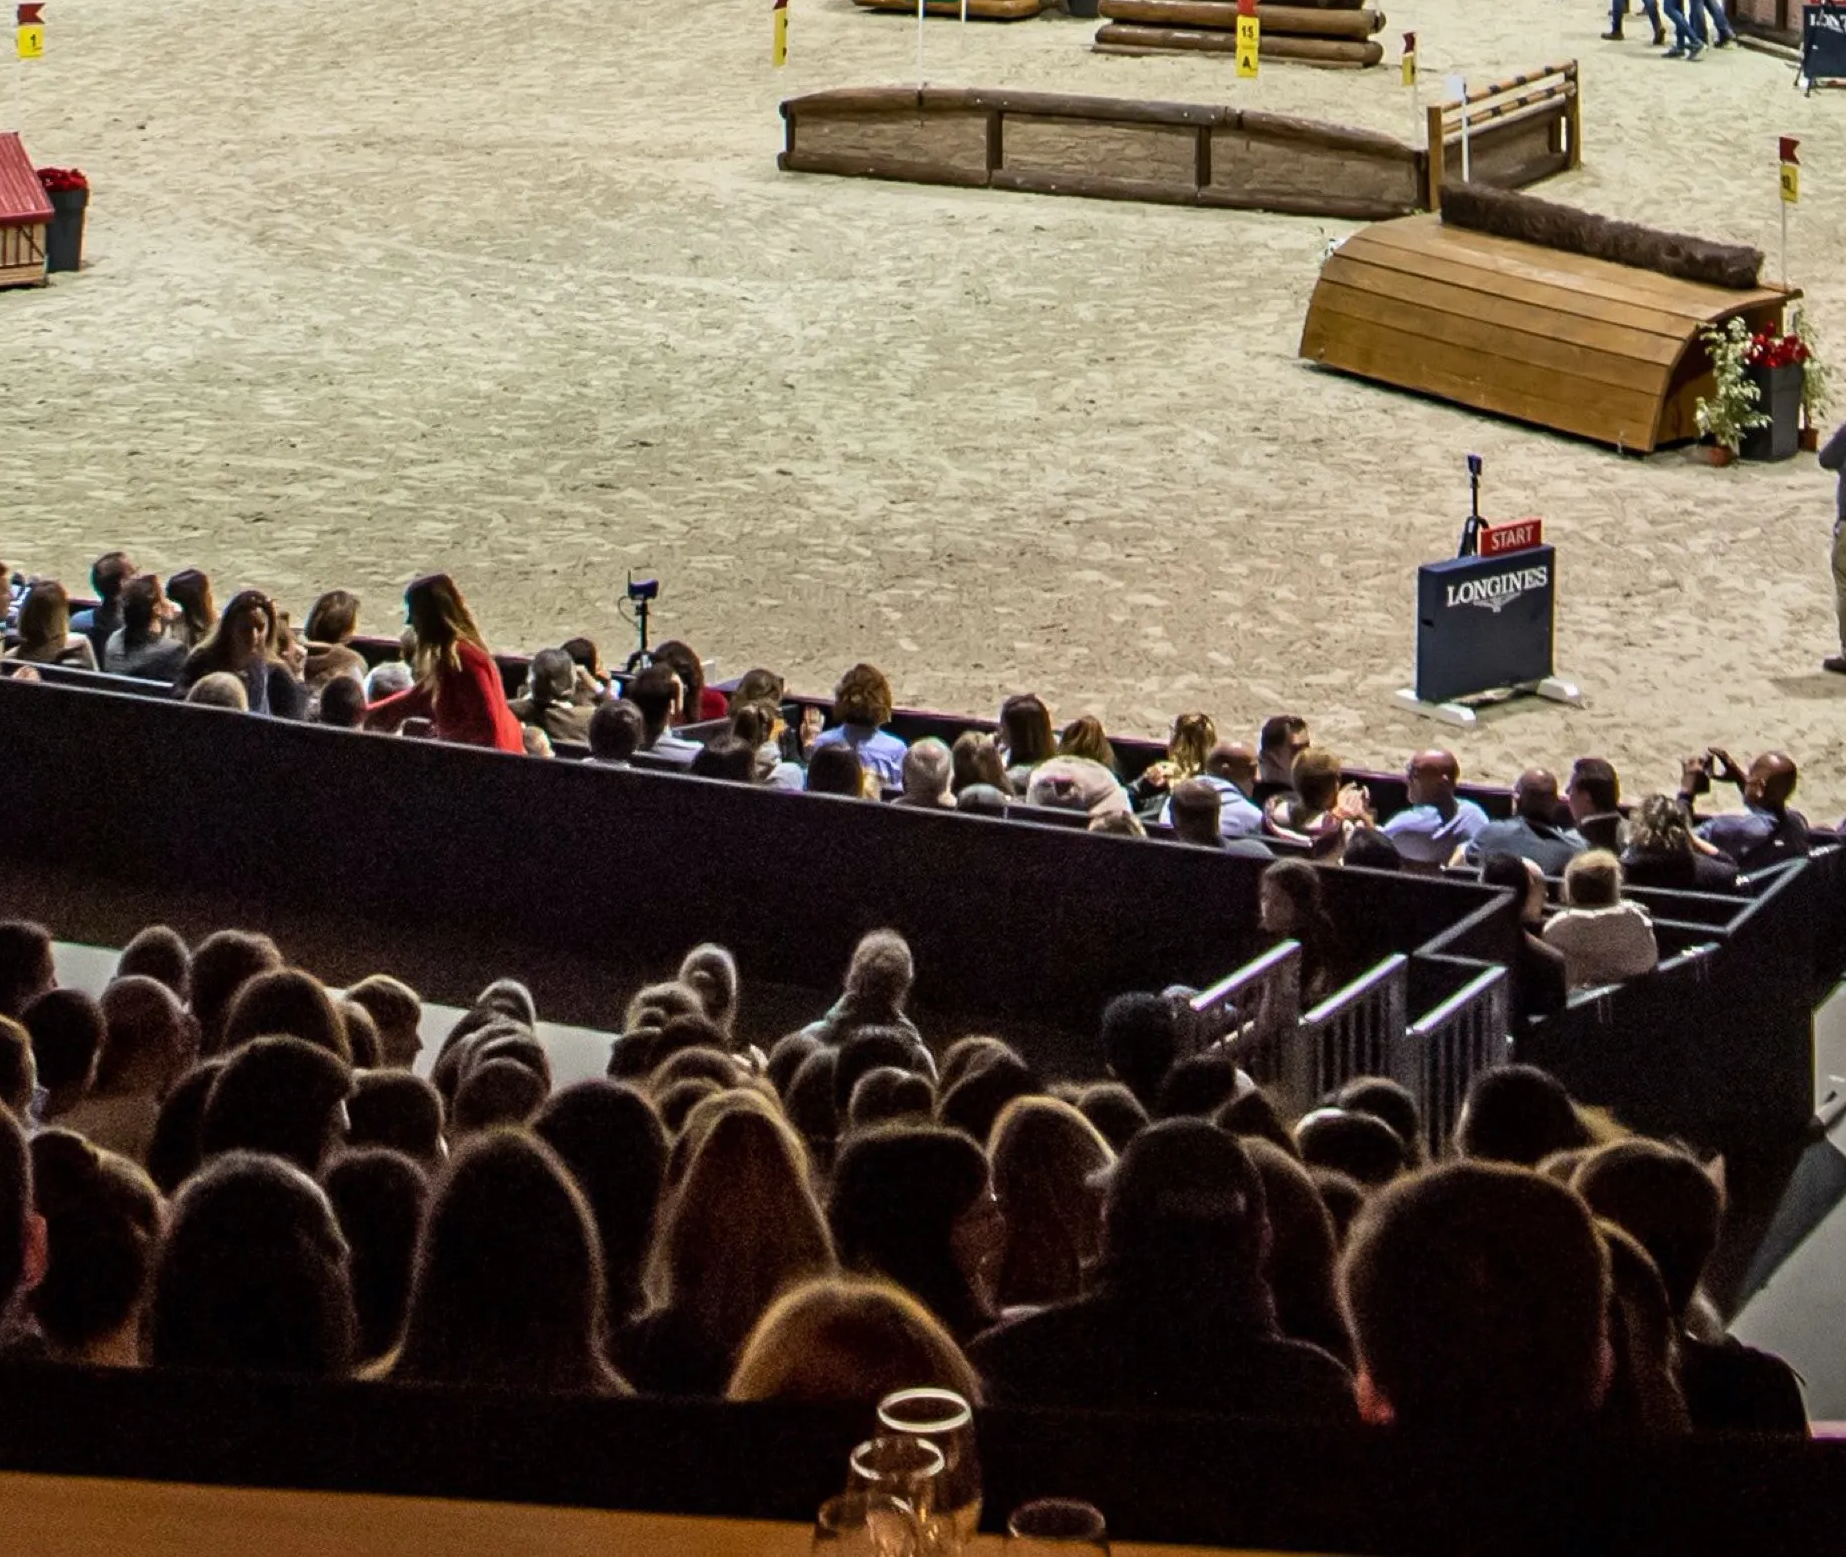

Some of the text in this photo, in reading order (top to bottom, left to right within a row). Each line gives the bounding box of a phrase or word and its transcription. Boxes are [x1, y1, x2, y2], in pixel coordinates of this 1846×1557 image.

[1242, 25, 1254, 39] 15
[1491, 526, 1533, 551] START
[1447, 566, 1548, 608] LONGINES
